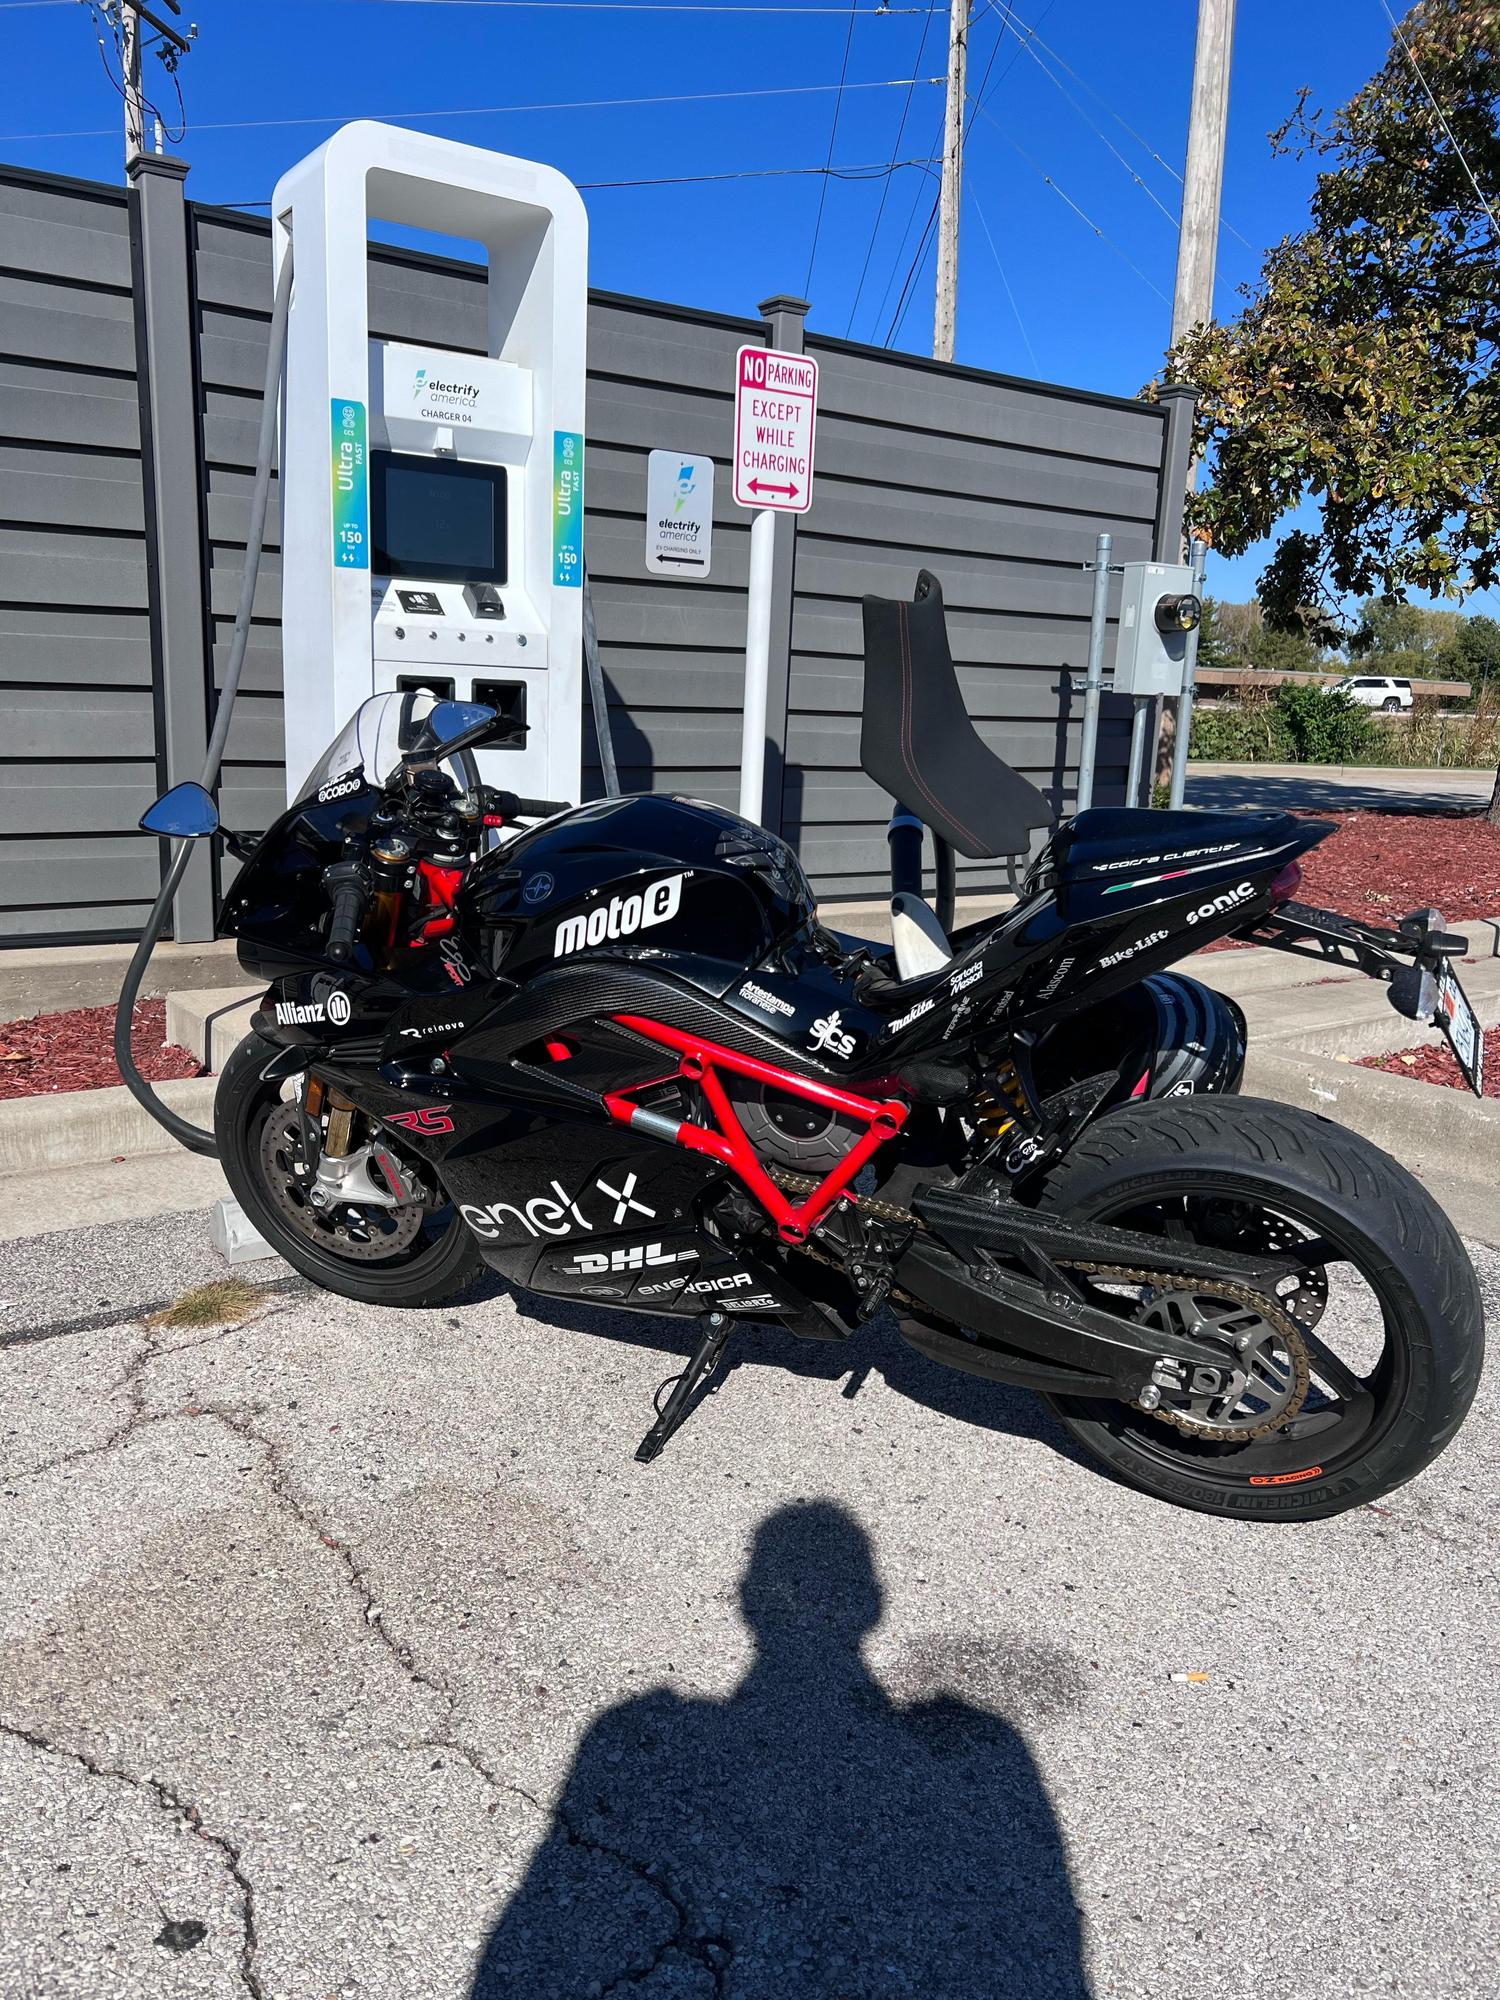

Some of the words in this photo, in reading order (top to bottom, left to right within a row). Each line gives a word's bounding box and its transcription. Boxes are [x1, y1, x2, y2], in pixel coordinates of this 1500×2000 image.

[744, 357, 764, 383] NO
[768, 364, 812, 389] PARKING
[429, 380, 479, 398] electrify
[421, 409, 460, 421] CHARGER
[462, 414, 472, 422] 04
[753, 400, 802, 423] EXCEPT
[756, 426, 795, 448] WHILE
[337, 442, 353, 491] Ultra
[743, 451, 806, 475] CHARGING
[558, 471, 571, 515] Ultra
[339, 531, 362, 544] 150
[659, 518, 701, 534] electrify
[660, 531, 697, 541] america
[558, 552, 577, 564] 150
[1186, 882, 1254, 925] sonic
[1100, 929, 1169, 969] Bike-Lift
[950, 961, 983, 986] Sartoria
[1036, 957, 1076, 1000] Alascom
[743, 981, 796, 1014] Artestampa
[275, 1001, 325, 1025] Allianz
[423, 1021, 465, 1035] reinova
[382, 1104, 455, 1136] RS
[459, 1180, 593, 1239] enel
[596, 1172, 656, 1225] X
[572, 1242, 677, 1274] DHL
[1278, 1471, 1313, 1482] RACING
